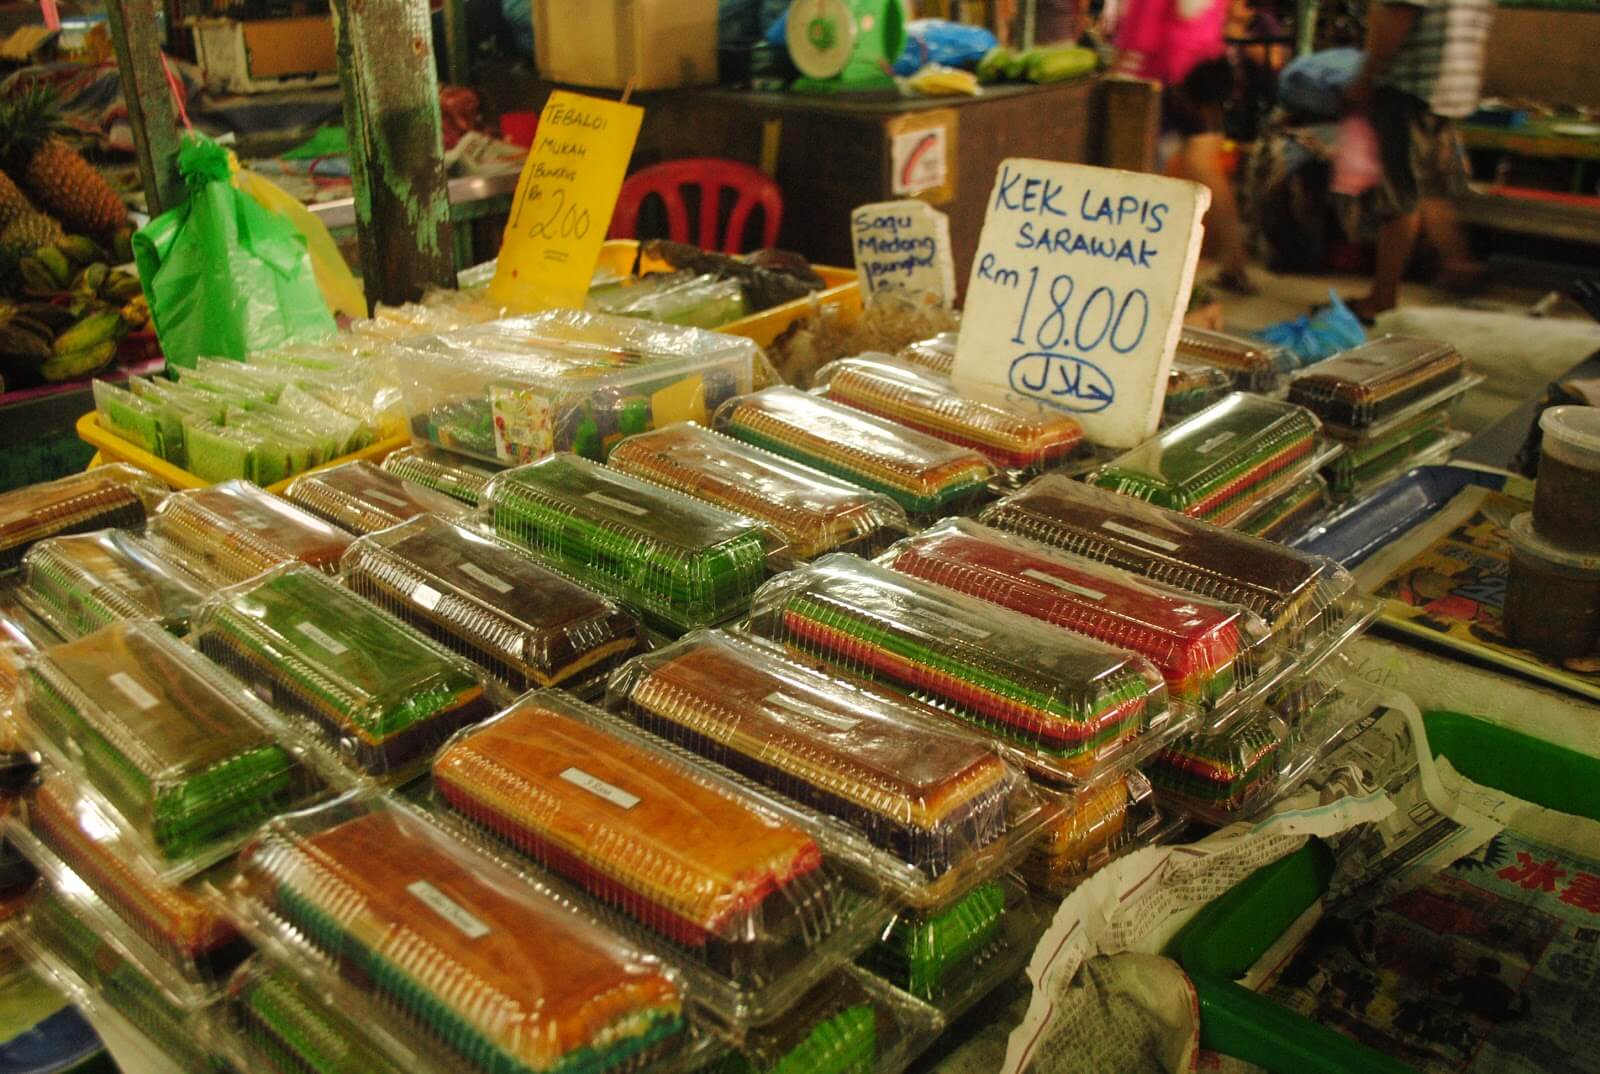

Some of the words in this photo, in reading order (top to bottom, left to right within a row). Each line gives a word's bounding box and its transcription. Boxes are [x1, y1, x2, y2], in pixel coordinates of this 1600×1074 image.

[855, 213, 912, 234] Sagu
[994, 166, 1068, 217] KEK
[1079, 189, 1169, 234] LAPIS
[1015, 221, 1158, 269] SARAWAK
[1010, 266, 1149, 354] 18.00
